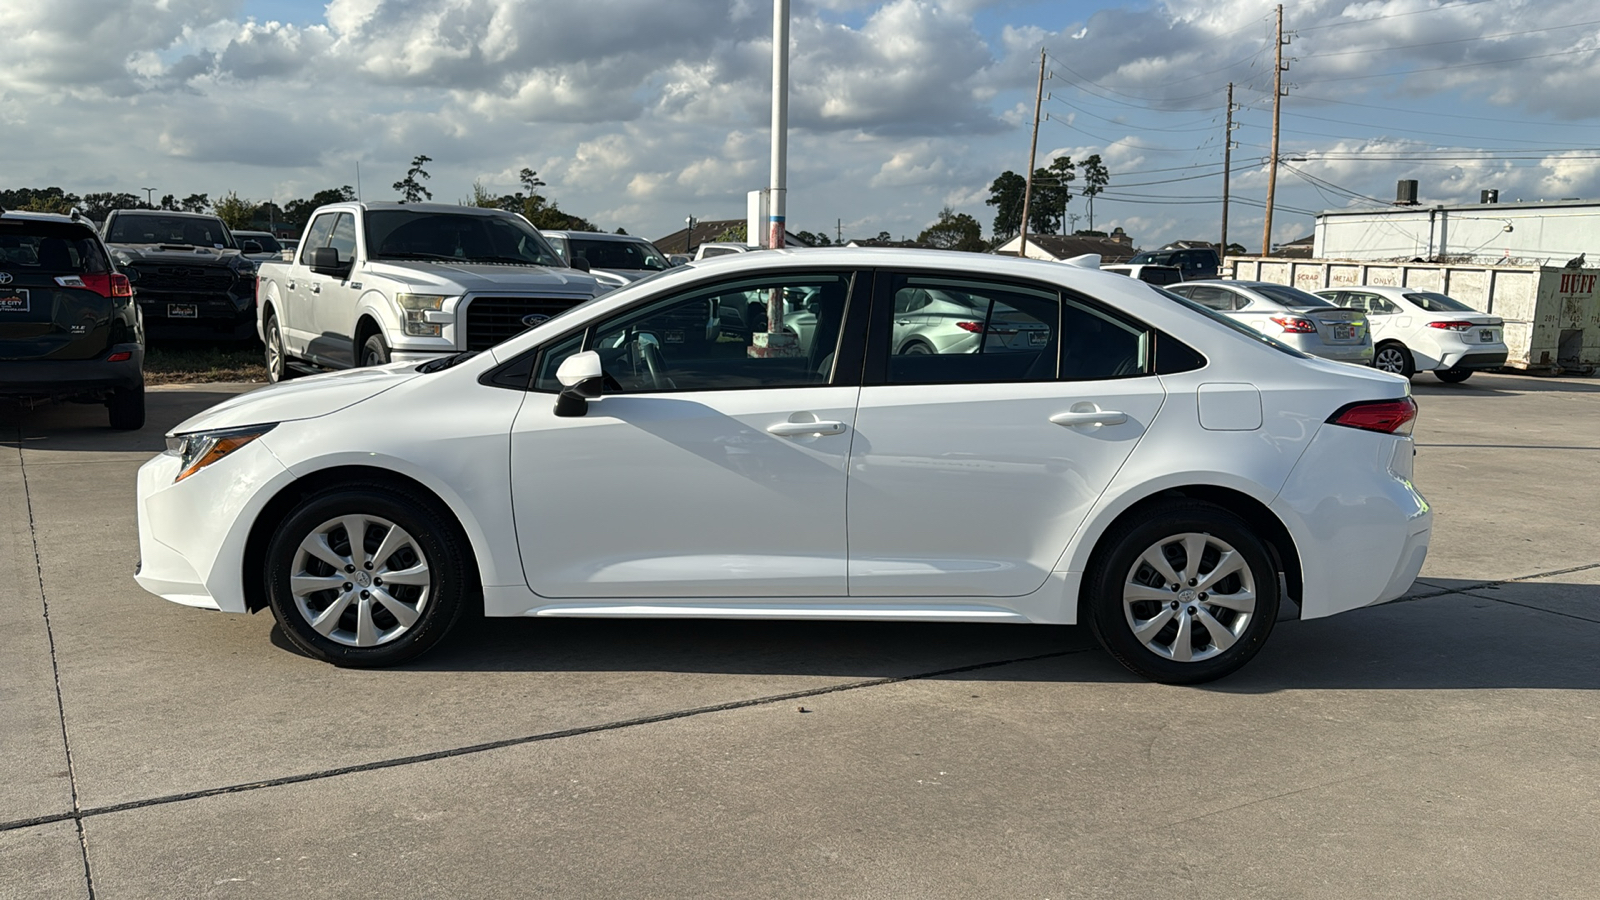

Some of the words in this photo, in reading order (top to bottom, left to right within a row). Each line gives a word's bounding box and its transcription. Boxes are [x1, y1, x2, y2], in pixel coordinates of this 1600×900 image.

[1332, 275, 1353, 283] METAL
[1373, 277, 1392, 285] ONLY
[1559, 274, 1597, 293] HUFF
